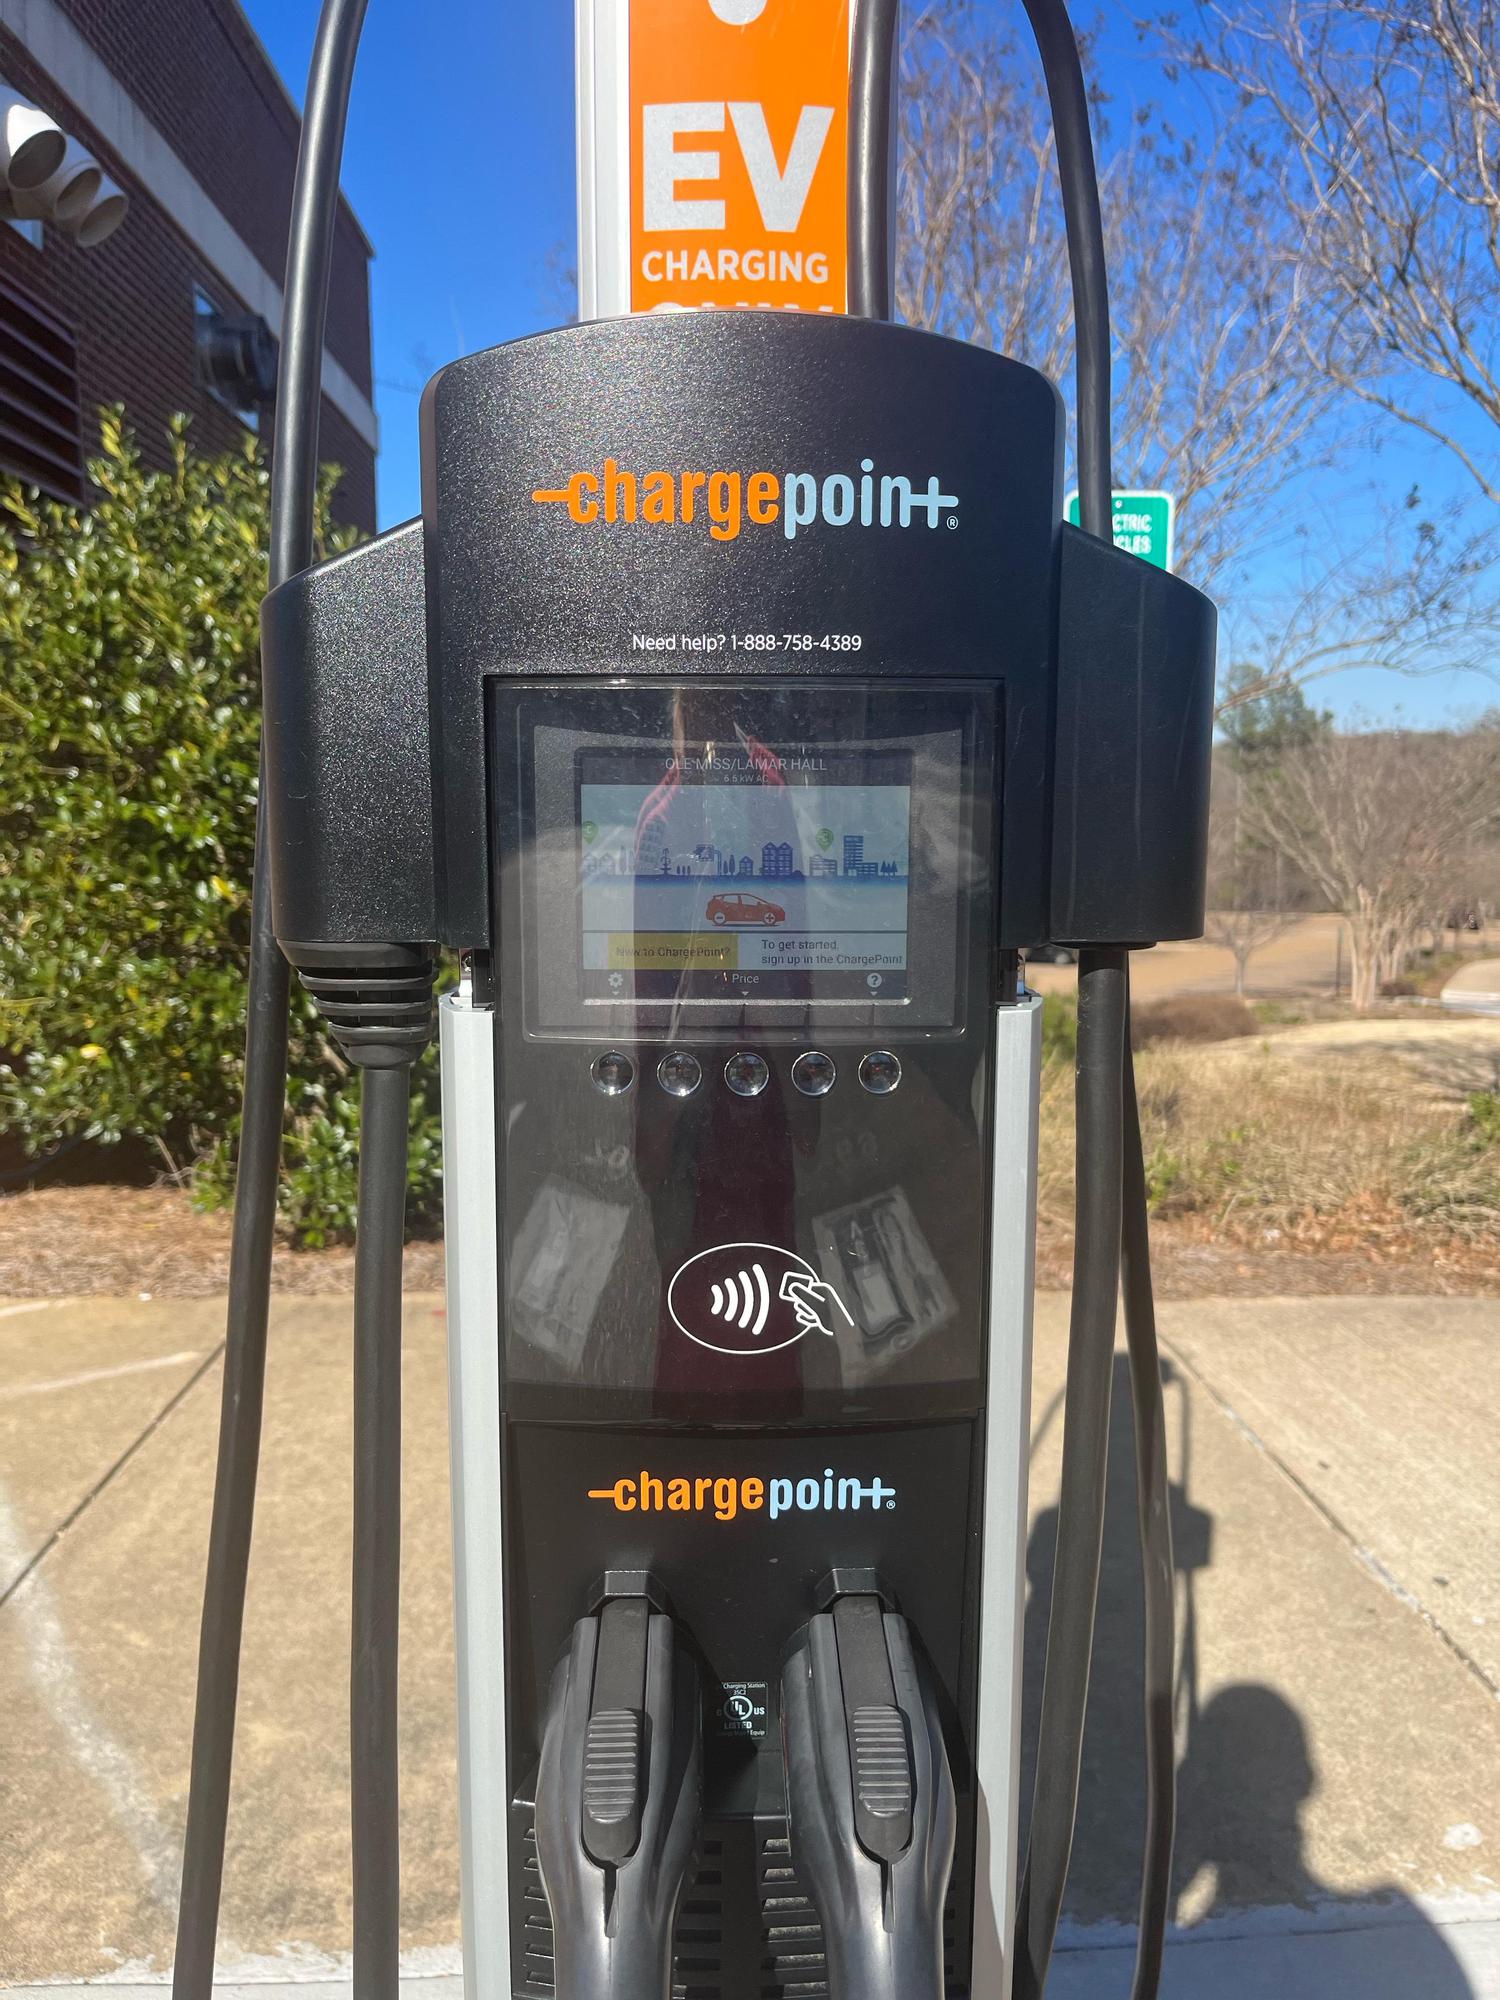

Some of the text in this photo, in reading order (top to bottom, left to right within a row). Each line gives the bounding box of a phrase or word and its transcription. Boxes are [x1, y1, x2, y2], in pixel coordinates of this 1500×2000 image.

[642, 101, 836, 234] EV
[641, 249, 829, 284] CHARGING
[1112, 513, 1153, 534] CTRIC
[632, 634, 862, 653] Need help? 1-888-758-4389
[665, 757, 692, 770] OLE
[790, 758, 828, 771] HALL
[761, 939, 776, 950] To
[778, 940, 796, 951] get
[761, 953, 903, 967] sign up in the ChargePoint
[732, 973, 760, 984] Price
